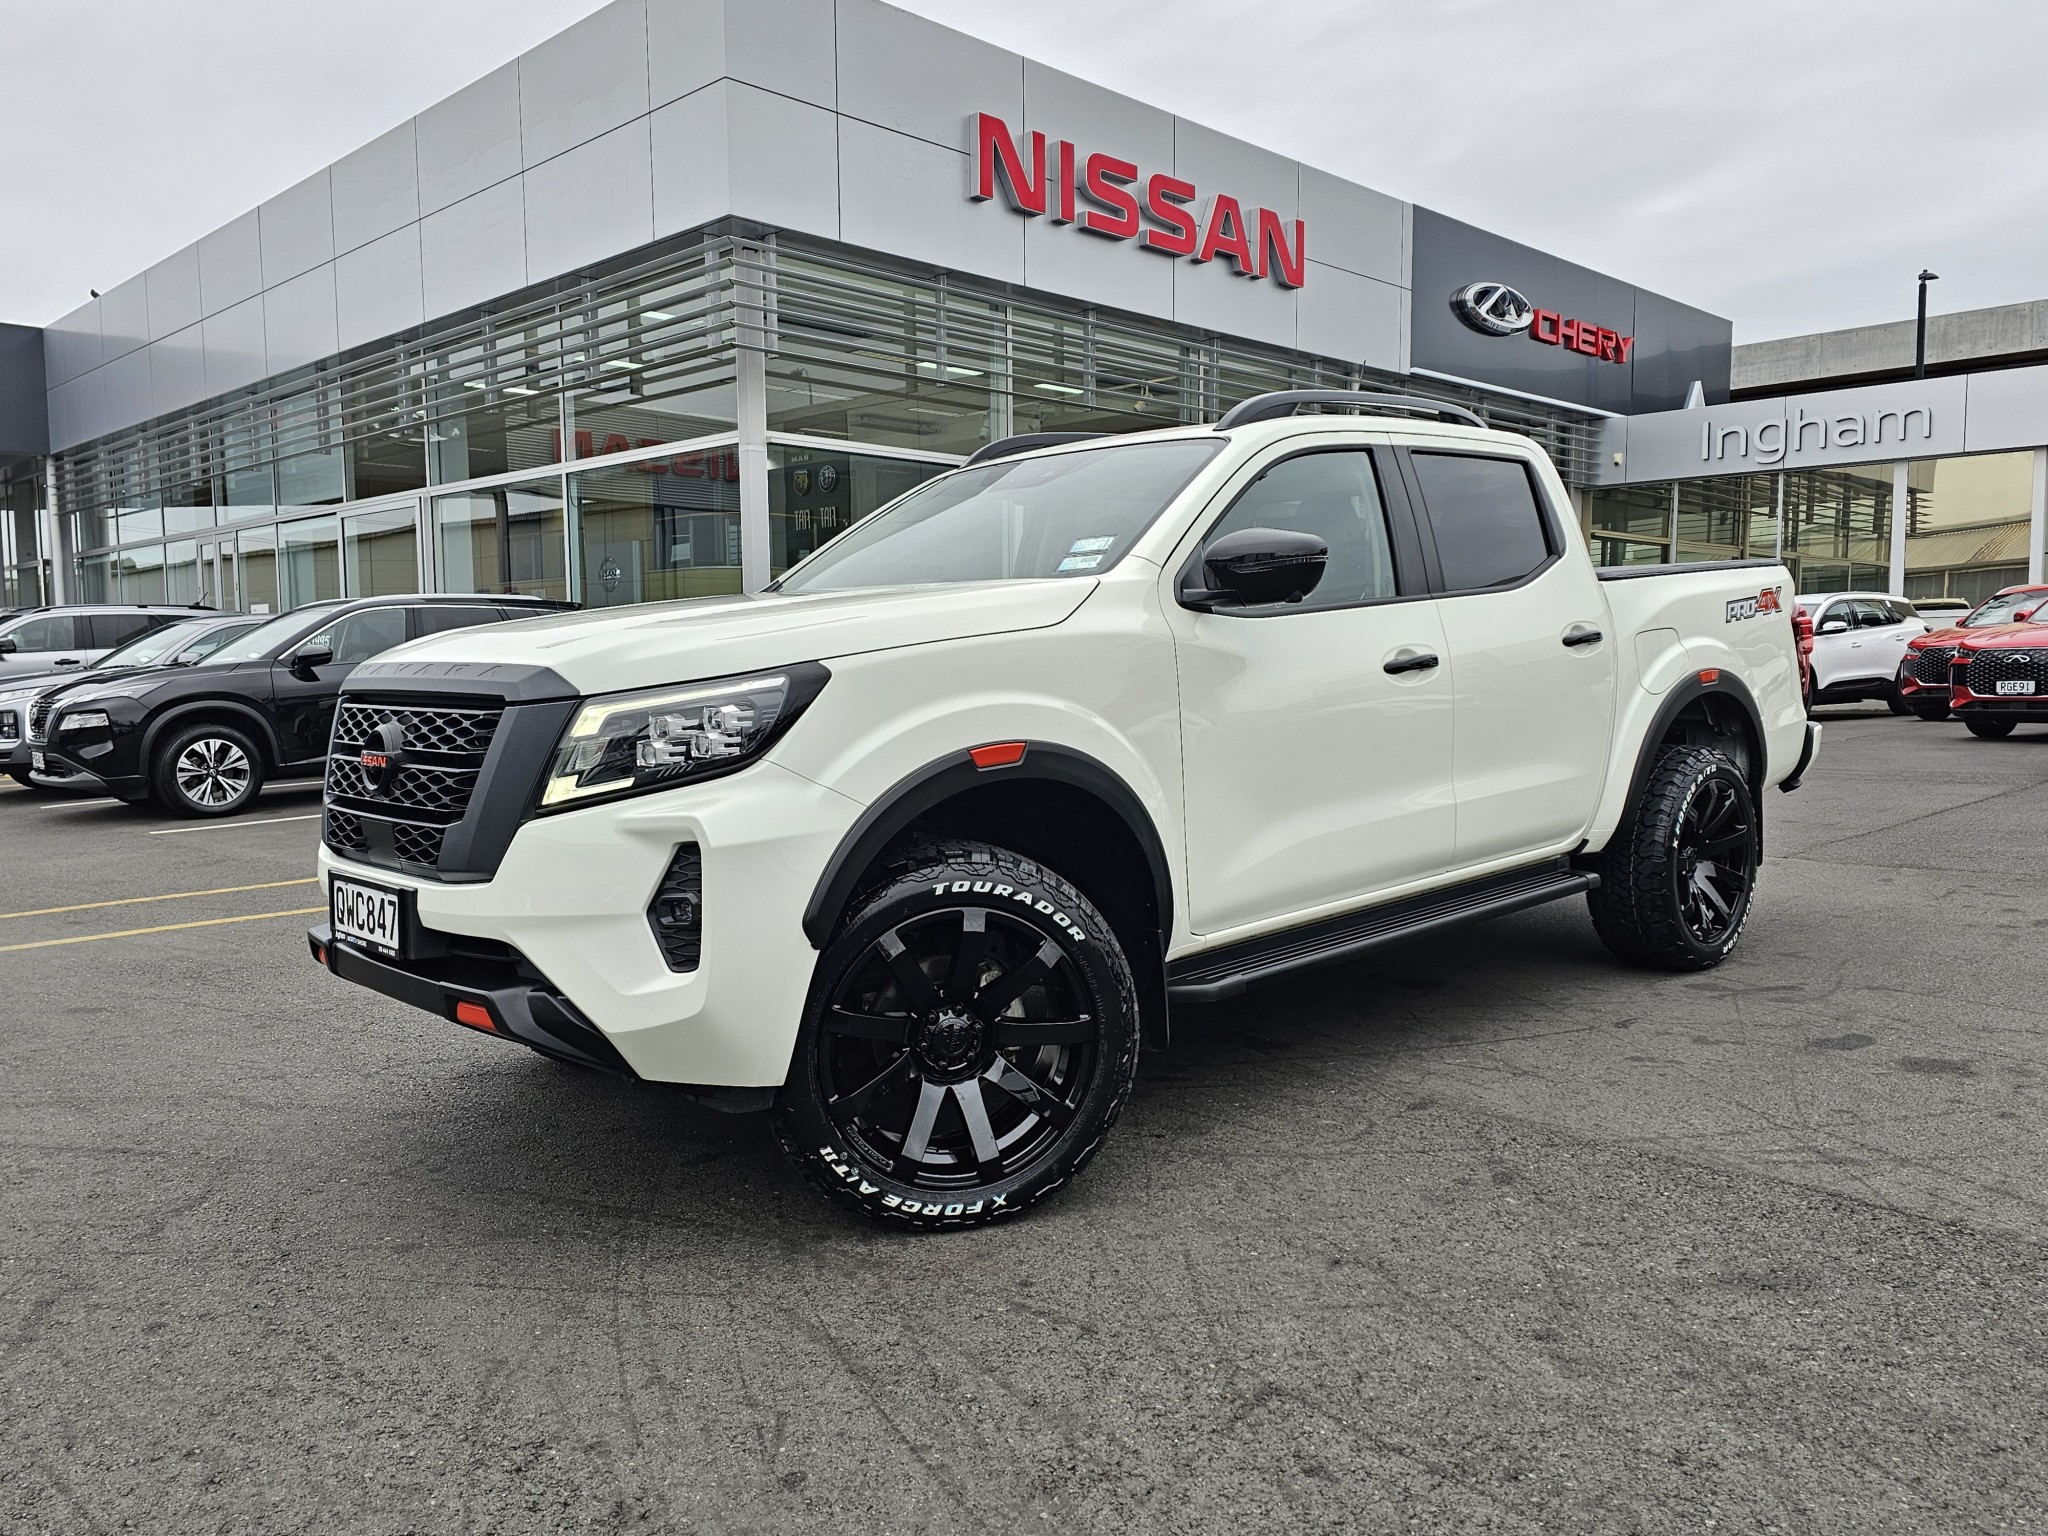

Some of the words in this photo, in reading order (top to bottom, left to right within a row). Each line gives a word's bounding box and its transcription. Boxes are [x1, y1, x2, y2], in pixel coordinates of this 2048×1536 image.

[970, 111, 1305, 288] NISSAN
[1530, 308, 1635, 364] CHERY
[1701, 406, 1932, 464] Ingham
[2000, 682, 2029, 692] RGE91
[336, 885, 397, 941] QWC847
[932, 881, 1086, 942] TOURADOR
[881, 1193, 984, 1216] FORCE
[991, 1193, 1007, 1209] X
